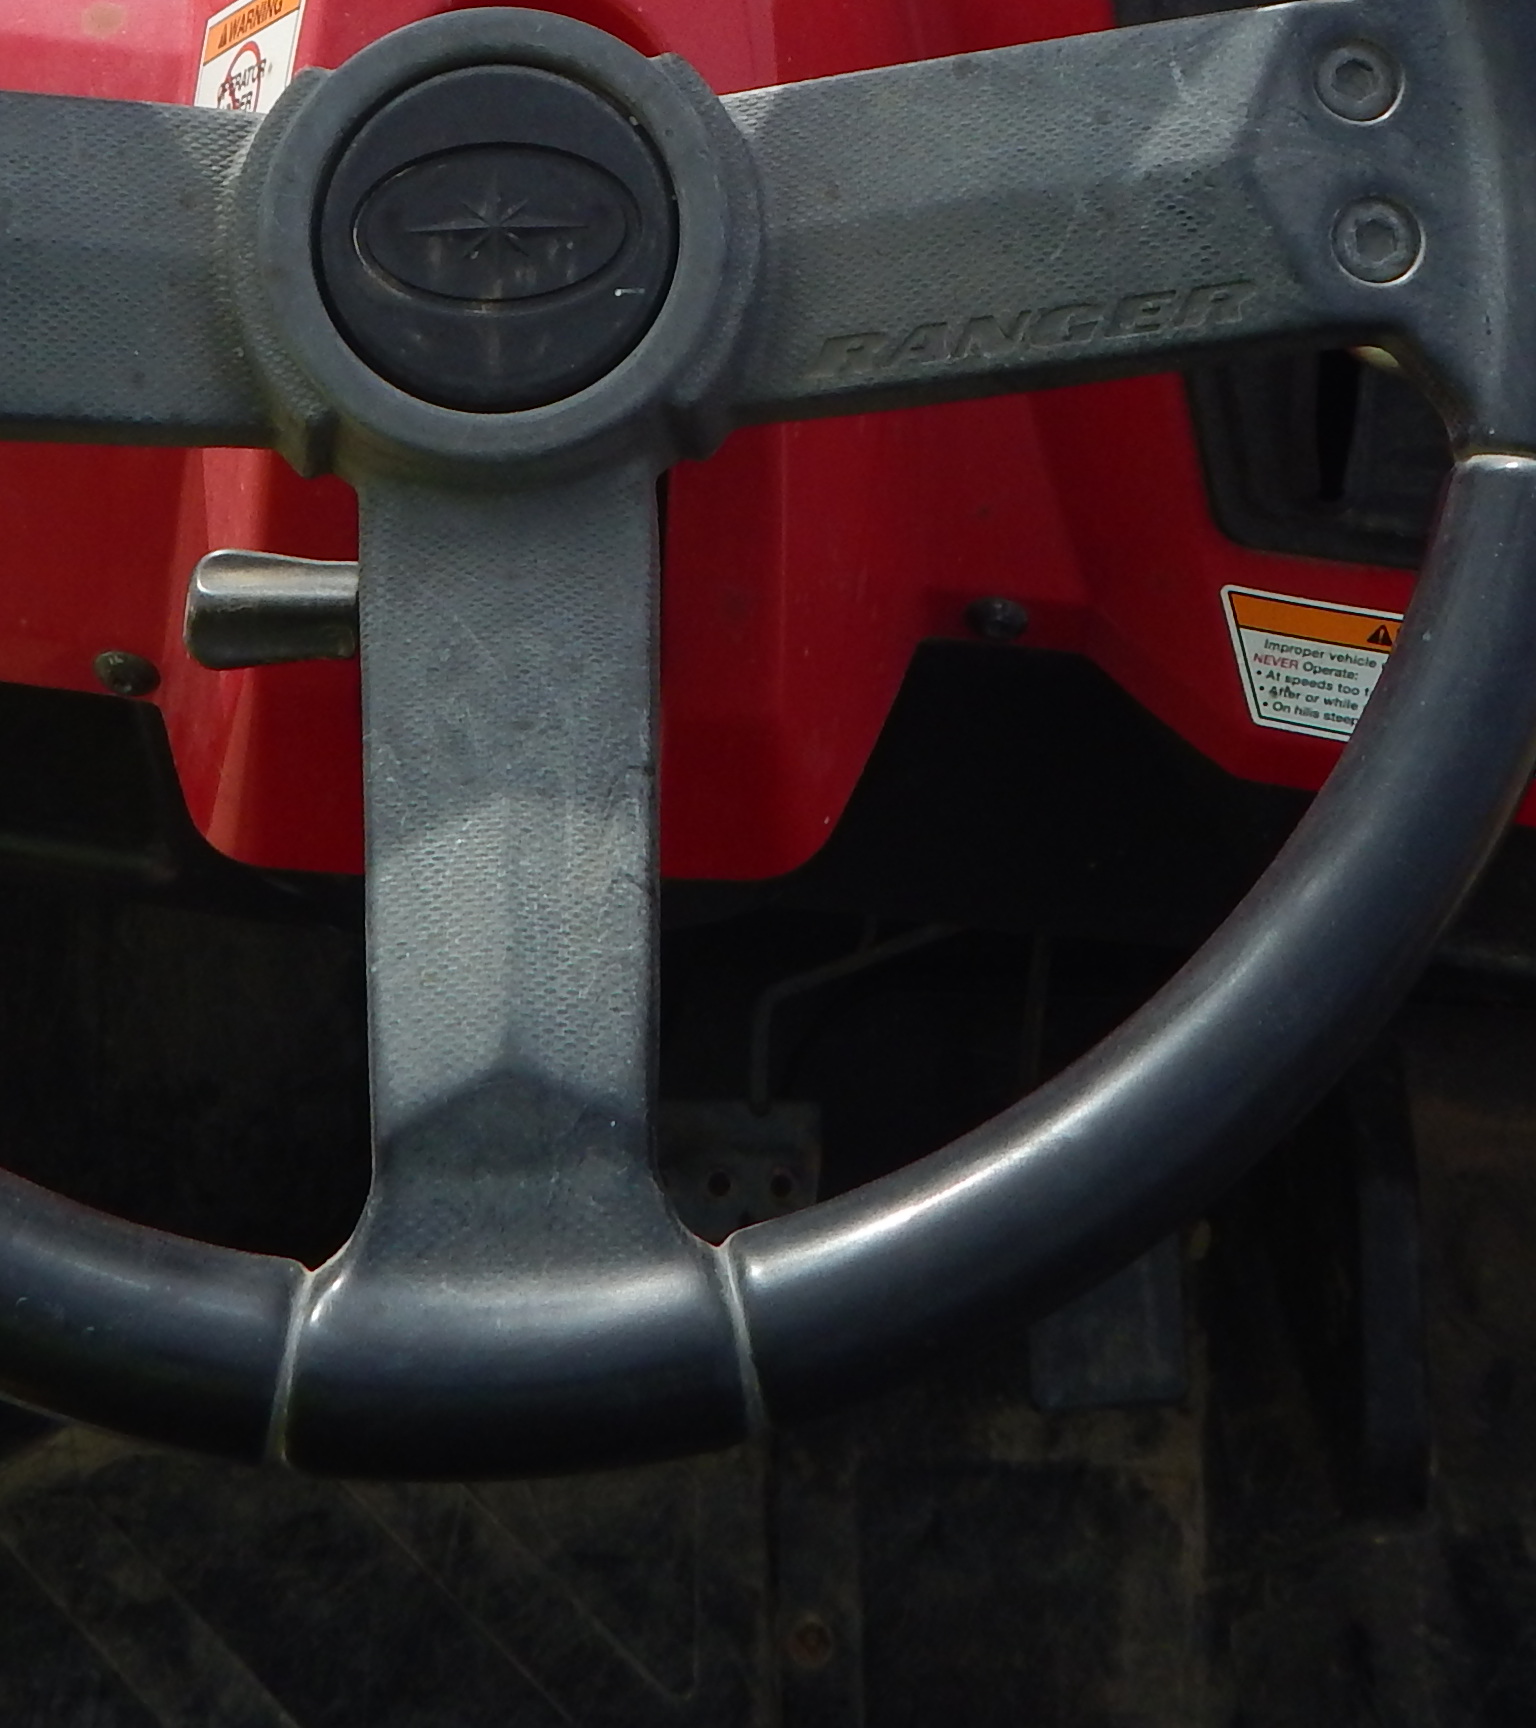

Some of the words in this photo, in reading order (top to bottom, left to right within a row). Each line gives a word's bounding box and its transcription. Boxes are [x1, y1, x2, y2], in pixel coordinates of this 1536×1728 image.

[808, 278, 1258, 374] RANGER
[1253, 653, 1299, 670] NEVER
[1302, 661, 1359, 681] Operate:
[1264, 639, 1324, 659] Improper
[1329, 652, 1377, 668] vehicle
[1265, 670, 1280, 682] At
[1284, 675, 1333, 691] speeds
[1337, 683, 1360, 696] too
[1272, 701, 1291, 713] On
[1294, 704, 1319, 718] hills
[1305, 694, 1319, 703] or
[1324, 694, 1359, 710] while
